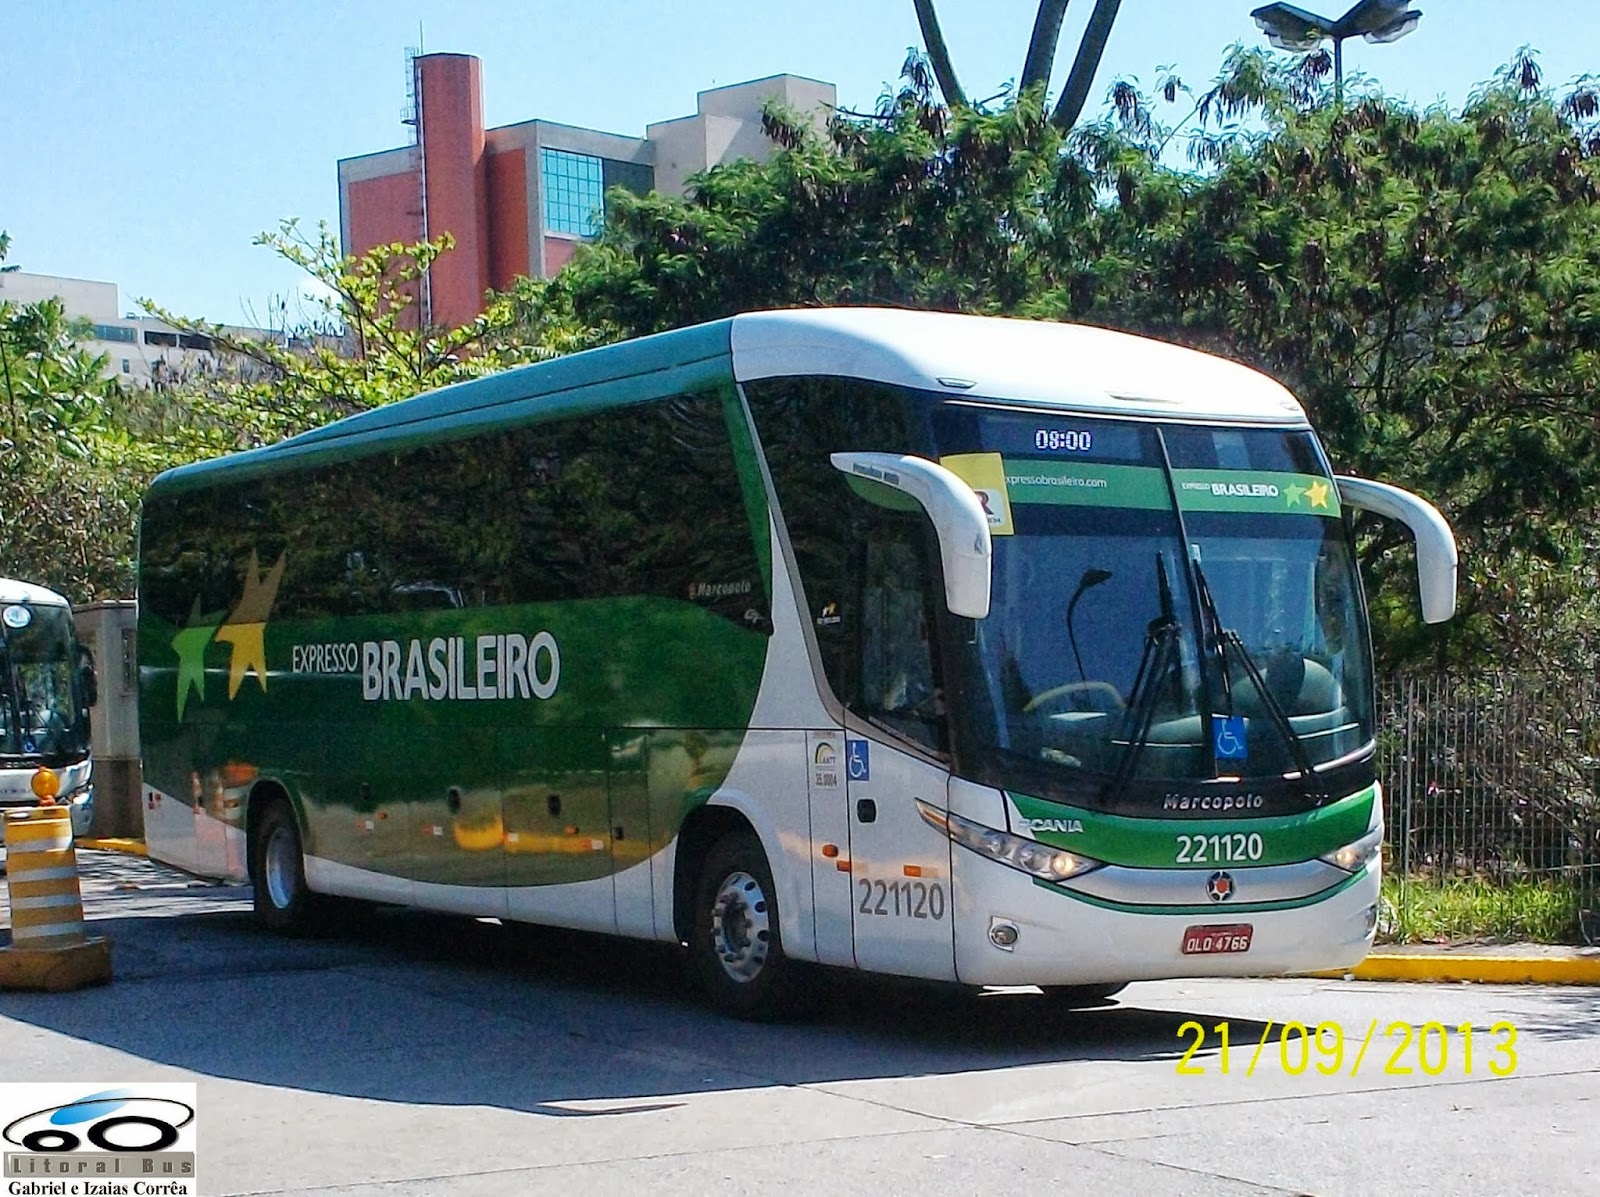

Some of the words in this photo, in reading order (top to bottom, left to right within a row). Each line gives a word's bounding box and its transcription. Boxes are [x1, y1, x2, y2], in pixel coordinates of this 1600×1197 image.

[1035, 429, 1092, 451] 08:00
[1005, 474, 1107, 488] xpressobrasileiro.com
[1211, 483, 1279, 497] BRASILEIRO
[292, 642, 358, 673] EXPRESSO
[362, 631, 560, 700] BRASILEIRO
[1163, 793, 1264, 811] Marcopolo
[1019, 818, 1084, 833] SCANIA
[1175, 832, 1264, 863] 221120
[859, 878, 945, 920] 221120
